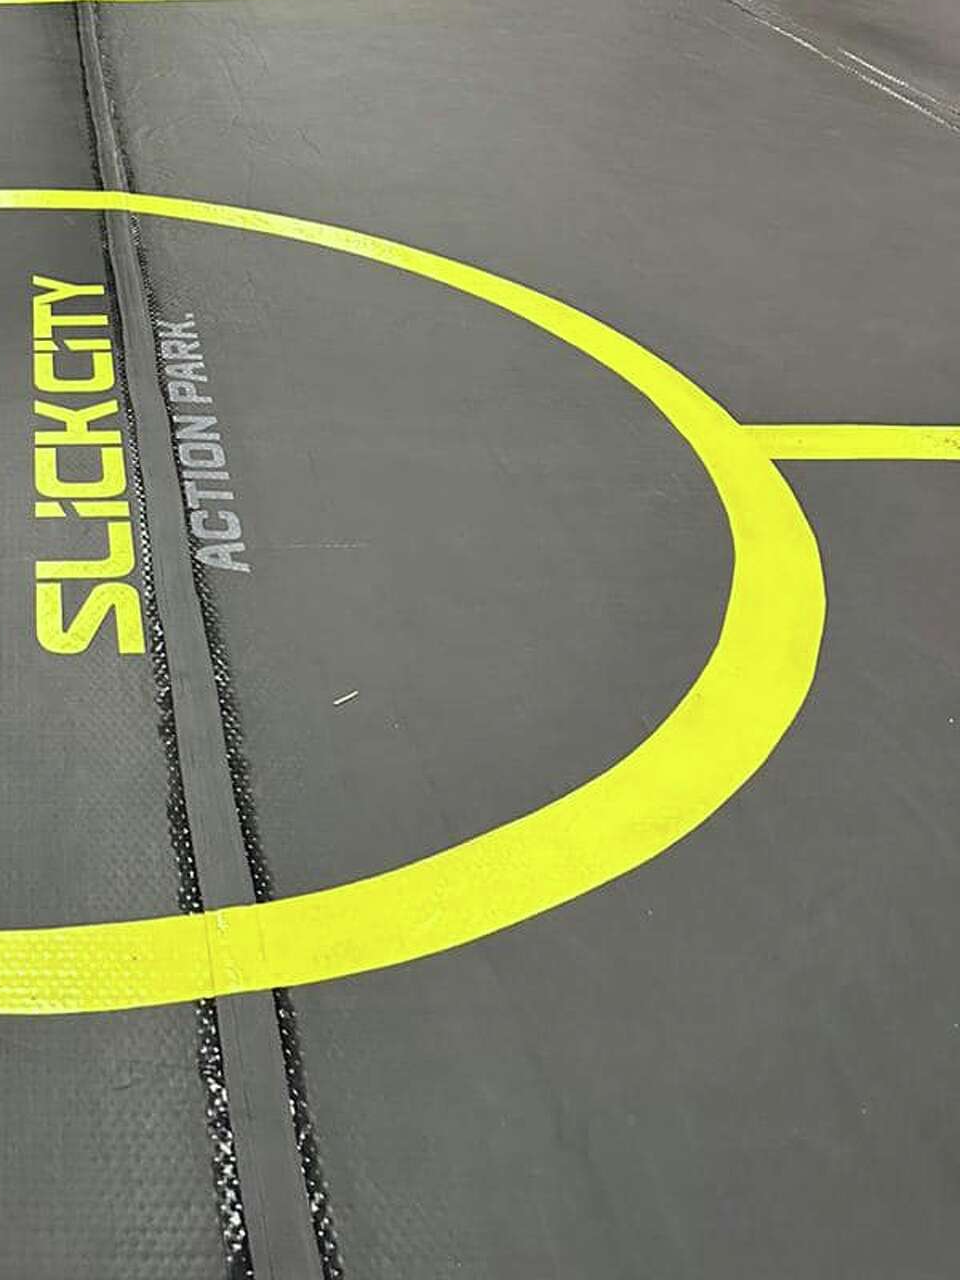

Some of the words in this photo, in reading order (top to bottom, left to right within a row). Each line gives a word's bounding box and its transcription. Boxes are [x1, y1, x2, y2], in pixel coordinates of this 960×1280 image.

[32, 275, 117, 392] CITY
[34, 399, 147, 656] SLICK
[172, 414, 251, 574] ACTION
